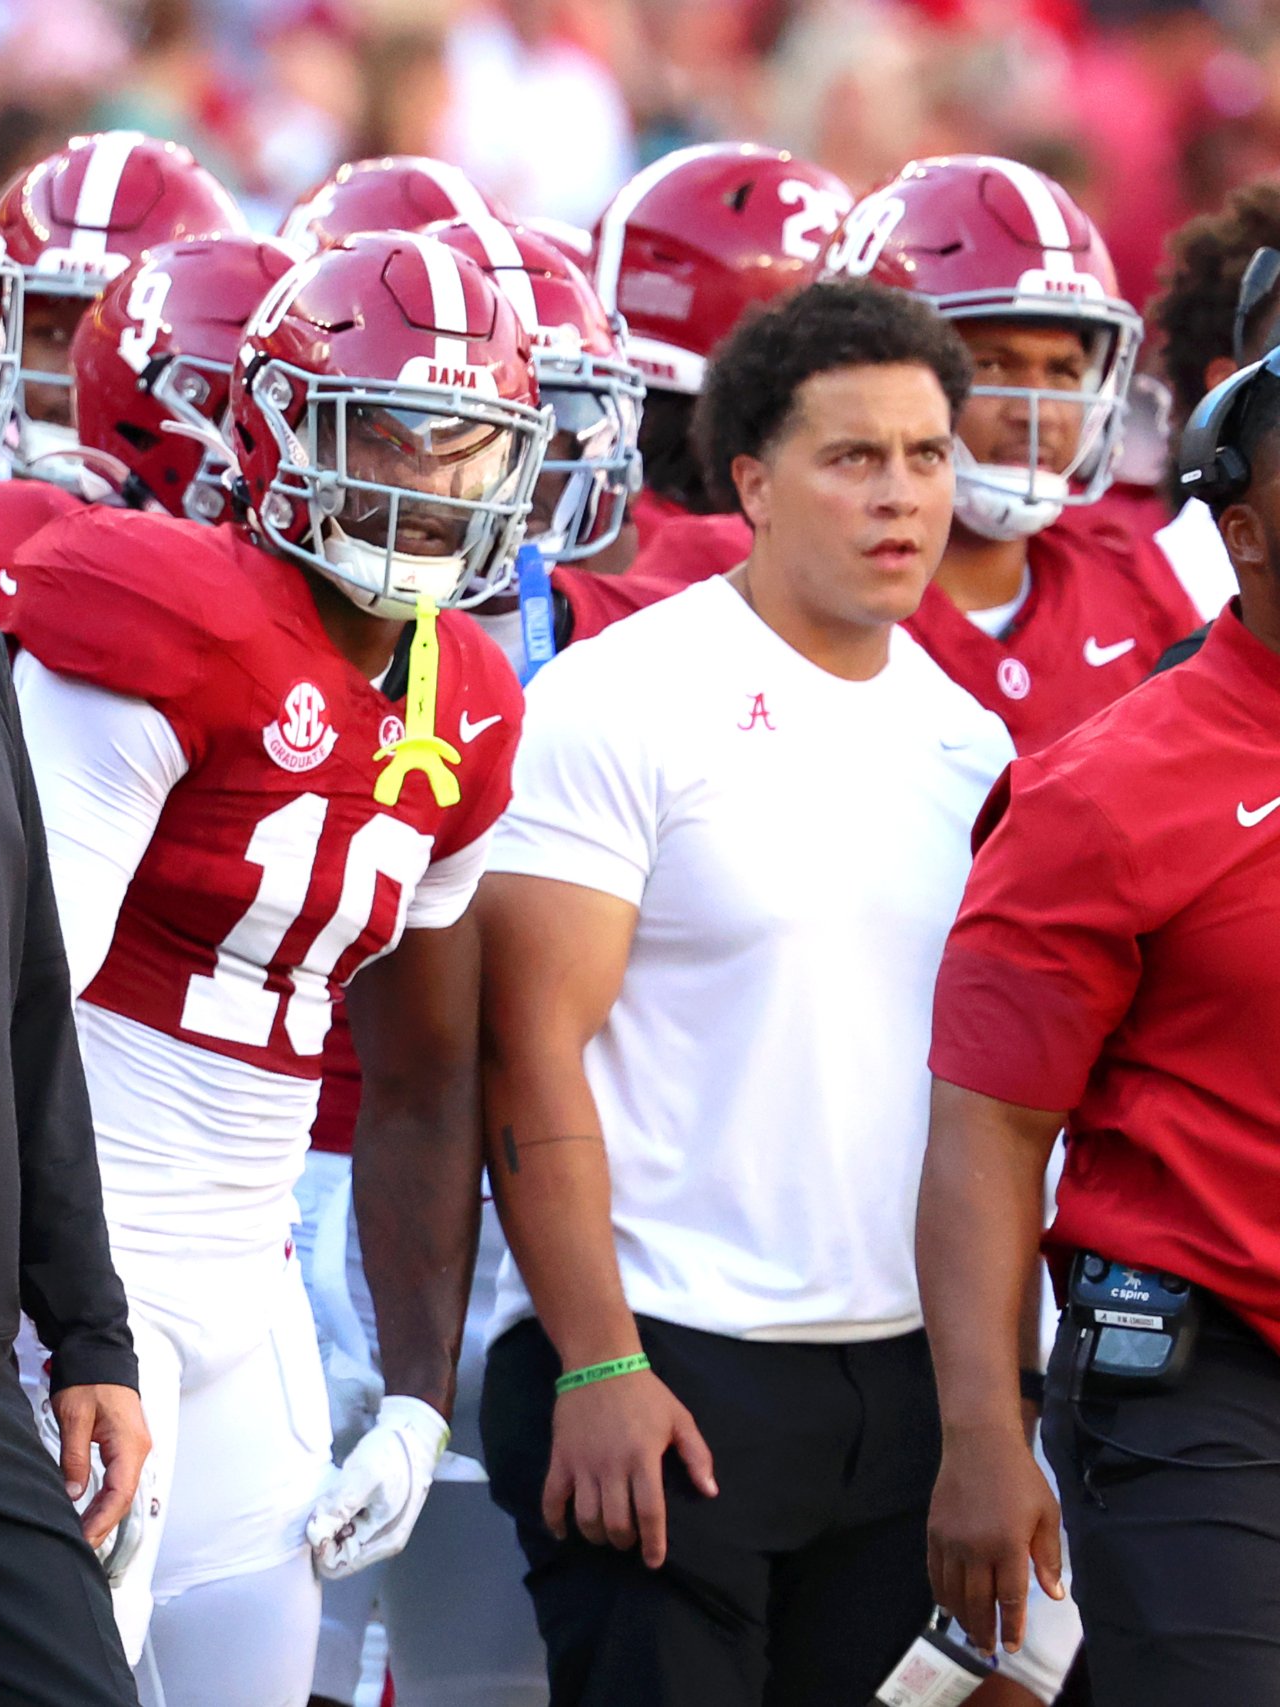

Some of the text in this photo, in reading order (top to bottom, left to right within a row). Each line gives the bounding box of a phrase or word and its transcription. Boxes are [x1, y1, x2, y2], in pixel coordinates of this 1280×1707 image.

[120, 264, 172, 360] 9
[428, 364, 478, 389] BAMA
[282, 682, 327, 748] SEC
[269, 738, 328, 769] GRADUATE
[180, 791, 436, 1056] 10
[1120, 1290, 1149, 1301] spire
